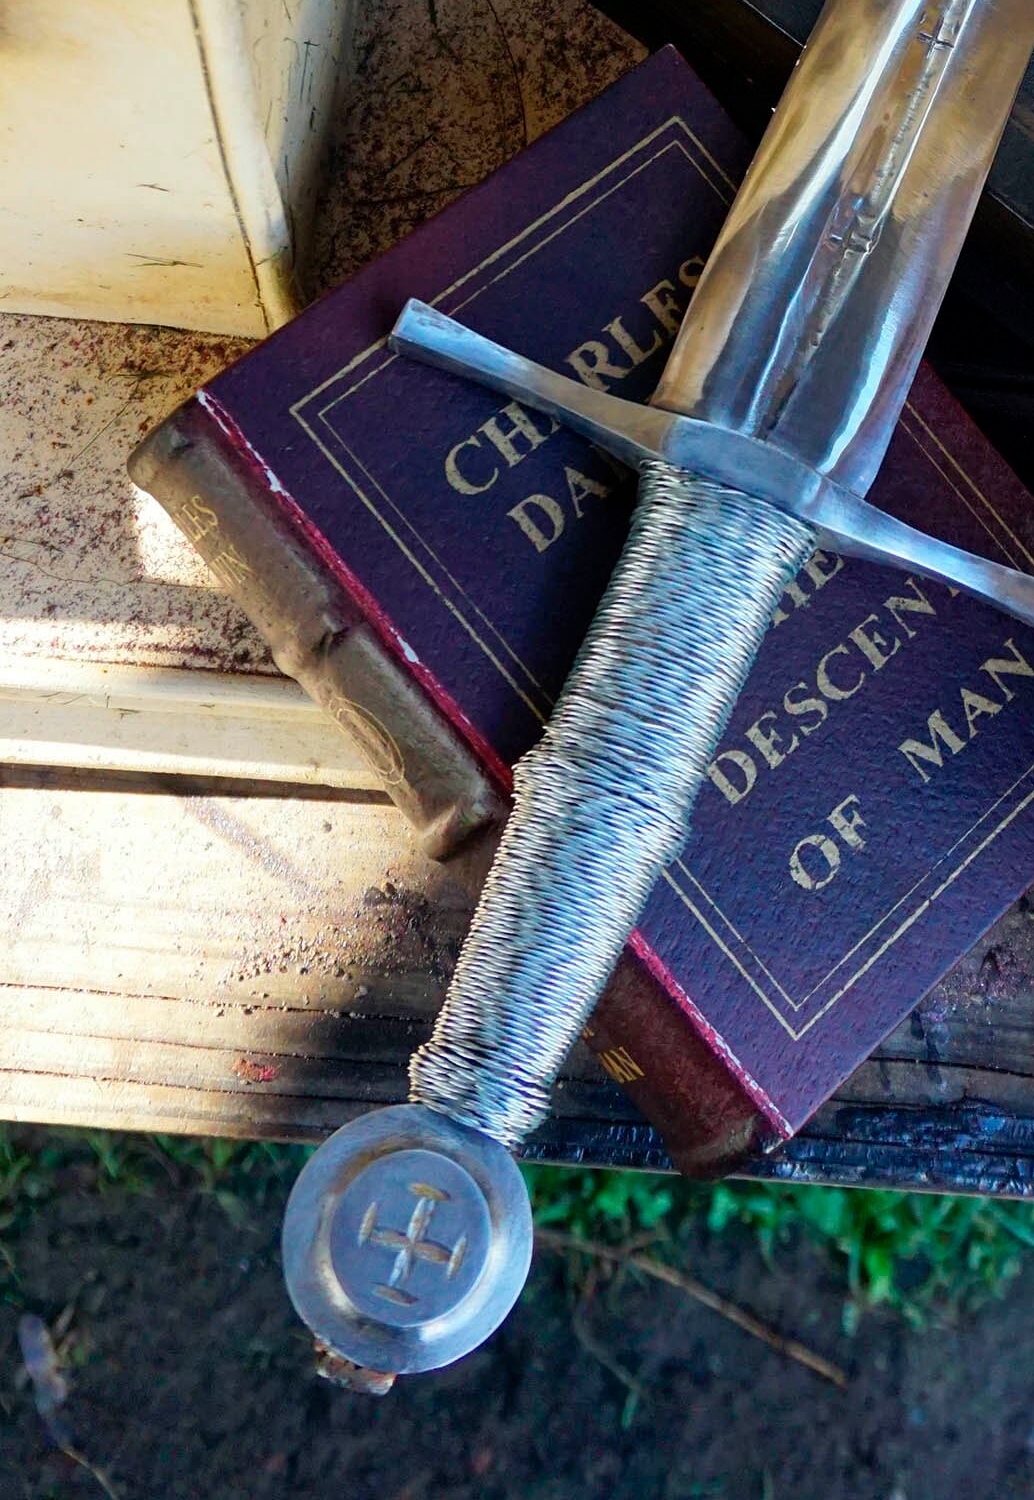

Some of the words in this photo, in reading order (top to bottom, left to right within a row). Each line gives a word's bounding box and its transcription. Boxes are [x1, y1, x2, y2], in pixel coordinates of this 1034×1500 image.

[445, 257, 705, 496] CHRLE
[707, 577, 960, 805] DESCEN
[789, 794, 867, 891] OF
